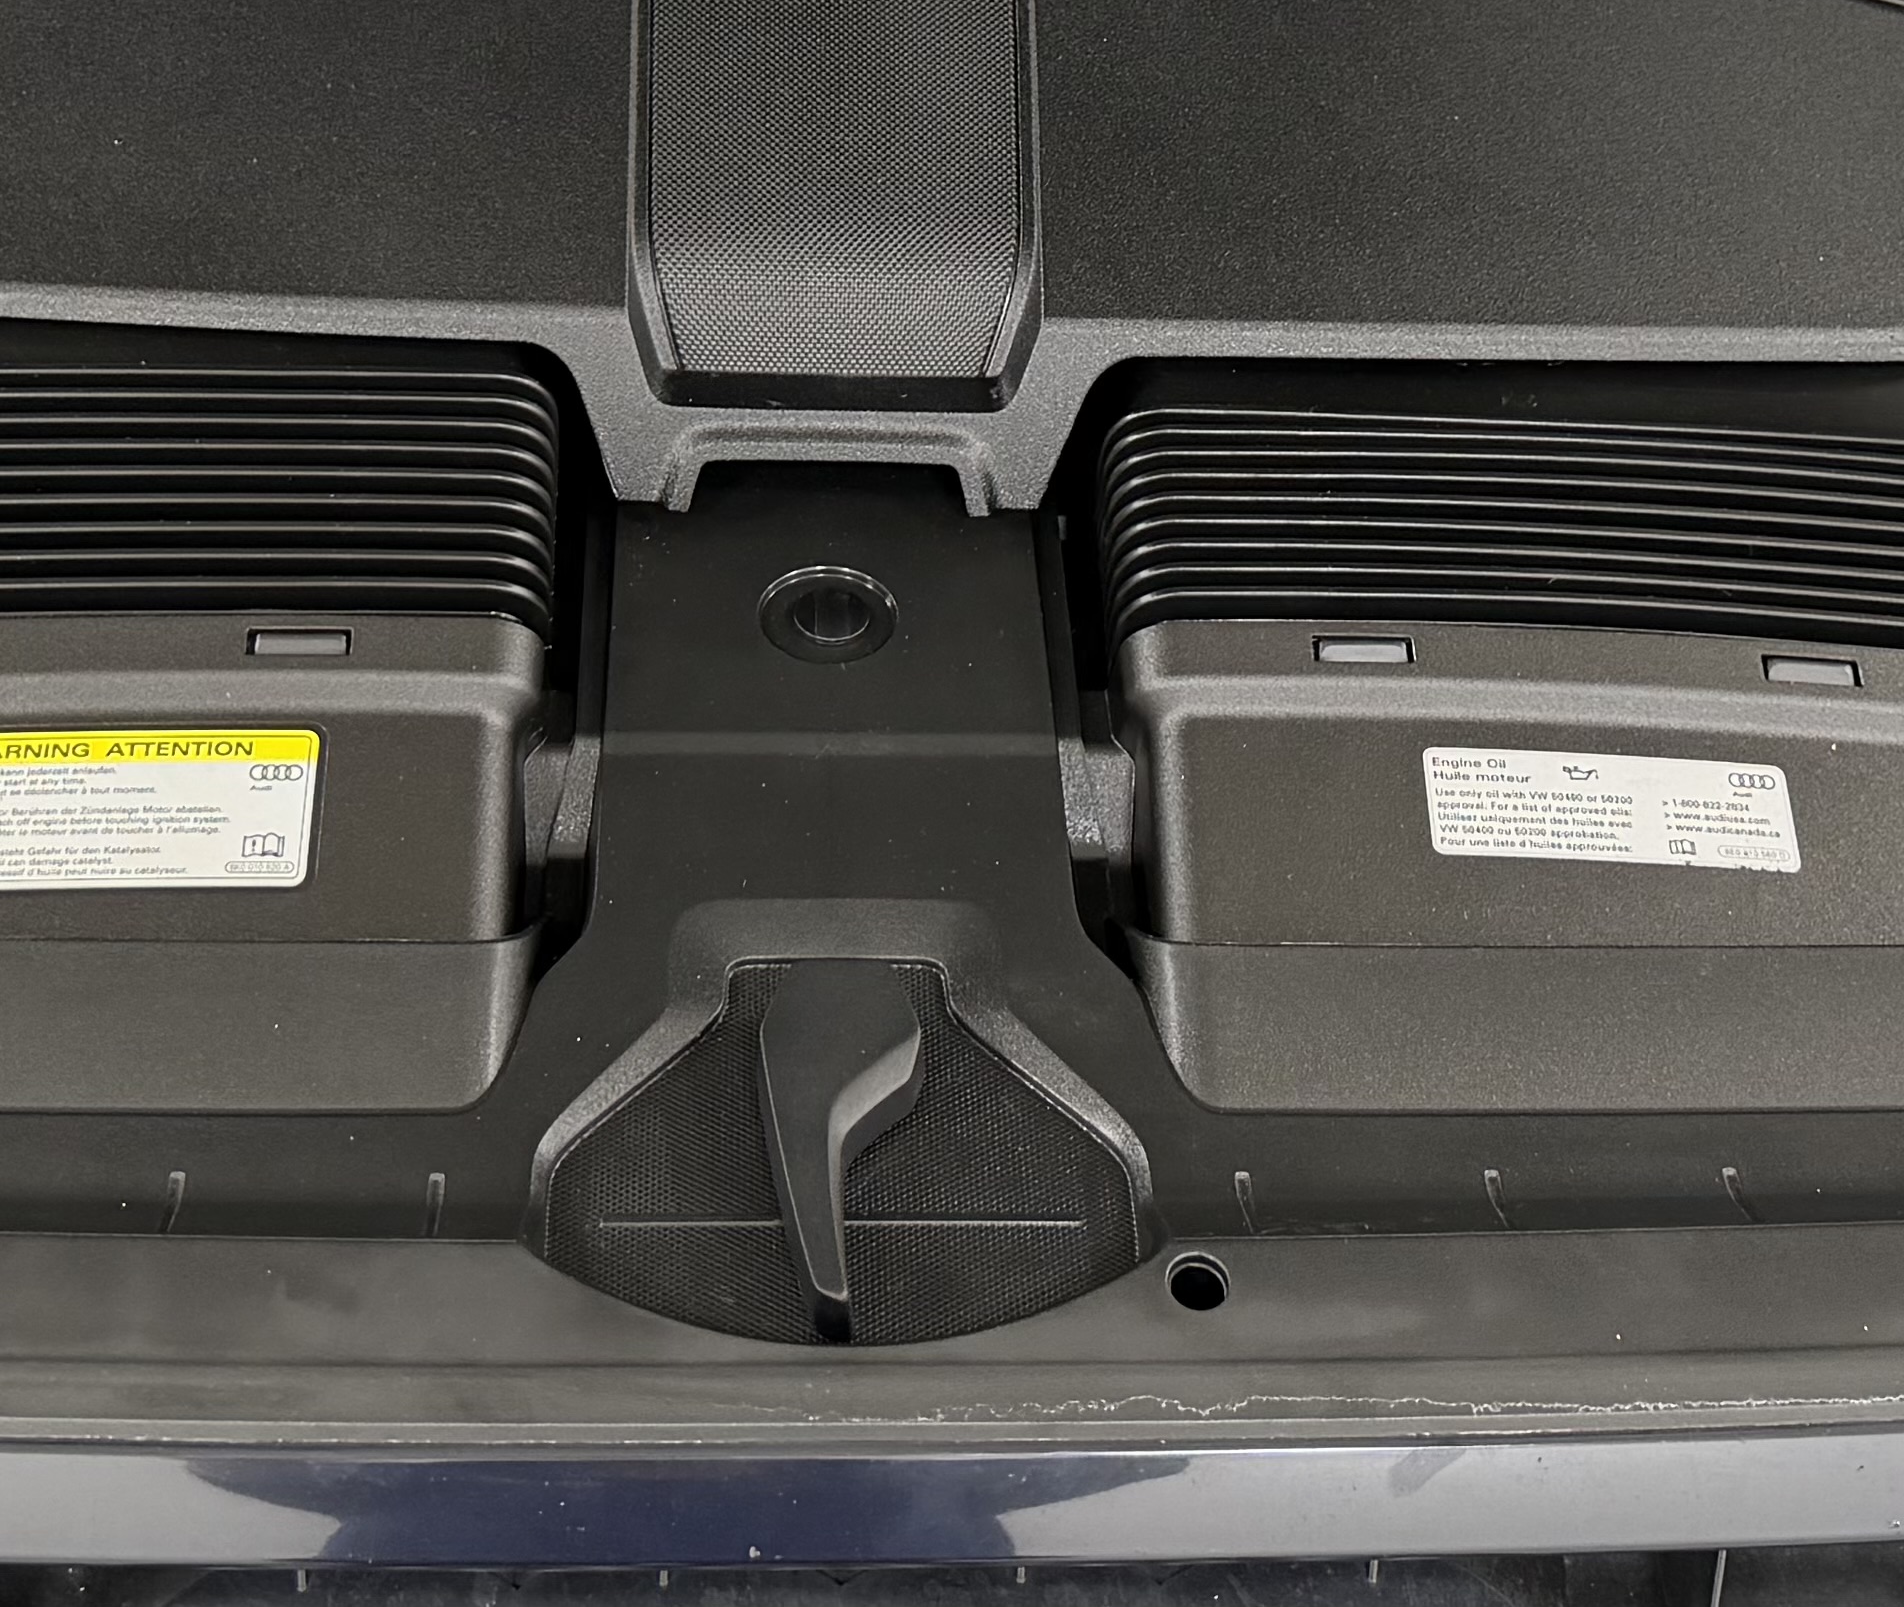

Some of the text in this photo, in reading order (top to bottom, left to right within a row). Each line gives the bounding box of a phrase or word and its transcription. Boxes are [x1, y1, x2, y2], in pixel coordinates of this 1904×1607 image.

[106, 741, 254, 757] ATTENTION
[1432, 756, 1507, 769] Engine Oil
[0, 768, 25, 777] kann
[72, 766, 116, 775] anlaufen.
[1433, 770, 1531, 783] Huile moteur
[3, 777, 26, 786] start
[29, 777, 38, 785] at
[41, 777, 59, 787] any
[62, 776, 87, 785] time.
[9, 789, 22, 797] se
[90, 786, 110, 794] tout
[113, 785, 157, 794] moment.
[1435, 787, 1456, 797] Use
[1459, 789, 1482, 799] only
[1485, 790, 1499, 798] oil
[1502, 790, 1526, 799] with
[1529, 791, 1548, 800] VW
[1586, 795, 1597, 803] or
[61, 807, 77, 815] der
[80, 806, 139, 816] Zündanlage
[142, 805, 173, 814] Motor
[175, 806, 223, 814] abstellen.
[1491, 801, 1509, 810] For
[1521, 803, 1538, 812] list
[1541, 803, 1552, 813] of
[1555, 806, 1607, 815] approved
[16, 818, 31, 826] off
[32, 818, 67, 827] engine
[70, 816, 102, 825] before
[105, 816, 149, 826] touching
[152, 815, 190, 825] ignition
[193, 816, 231, 825] system.
[1480, 814, 1546, 825] uniquement
[1549, 817, 1569, 825] des
[1572, 817, 1605, 827] huiles
[1608, 820, 1633, 829] avec
[1673, 812, 1771, 825] www.audiusa.com
[18, 828, 28, 836] le
[31, 828, 67, 836] moteur
[69, 827, 97, 835] avant
[101, 826, 114, 835] de
[116, 826, 154, 834] toucher
[157, 826, 164, 834] à
[1439, 823, 1458, 833] VW
[1497, 828, 1512, 836] ou
[1675, 824, 1781, 838] www.audicanada.ca
[1440, 836, 1465, 846] Pour
[1469, 839, 1490, 847] une
[1493, 838, 1516, 848] liste
[27, 847, 61, 855] Gefahr
[65, 847, 79, 855] für
[81, 846, 101, 854] den
[29, 858, 70, 867] damage
[64, 866, 88, 876] peut
[90, 866, 116, 875] nuire
[134, 866, 188, 876] catalyseur.
